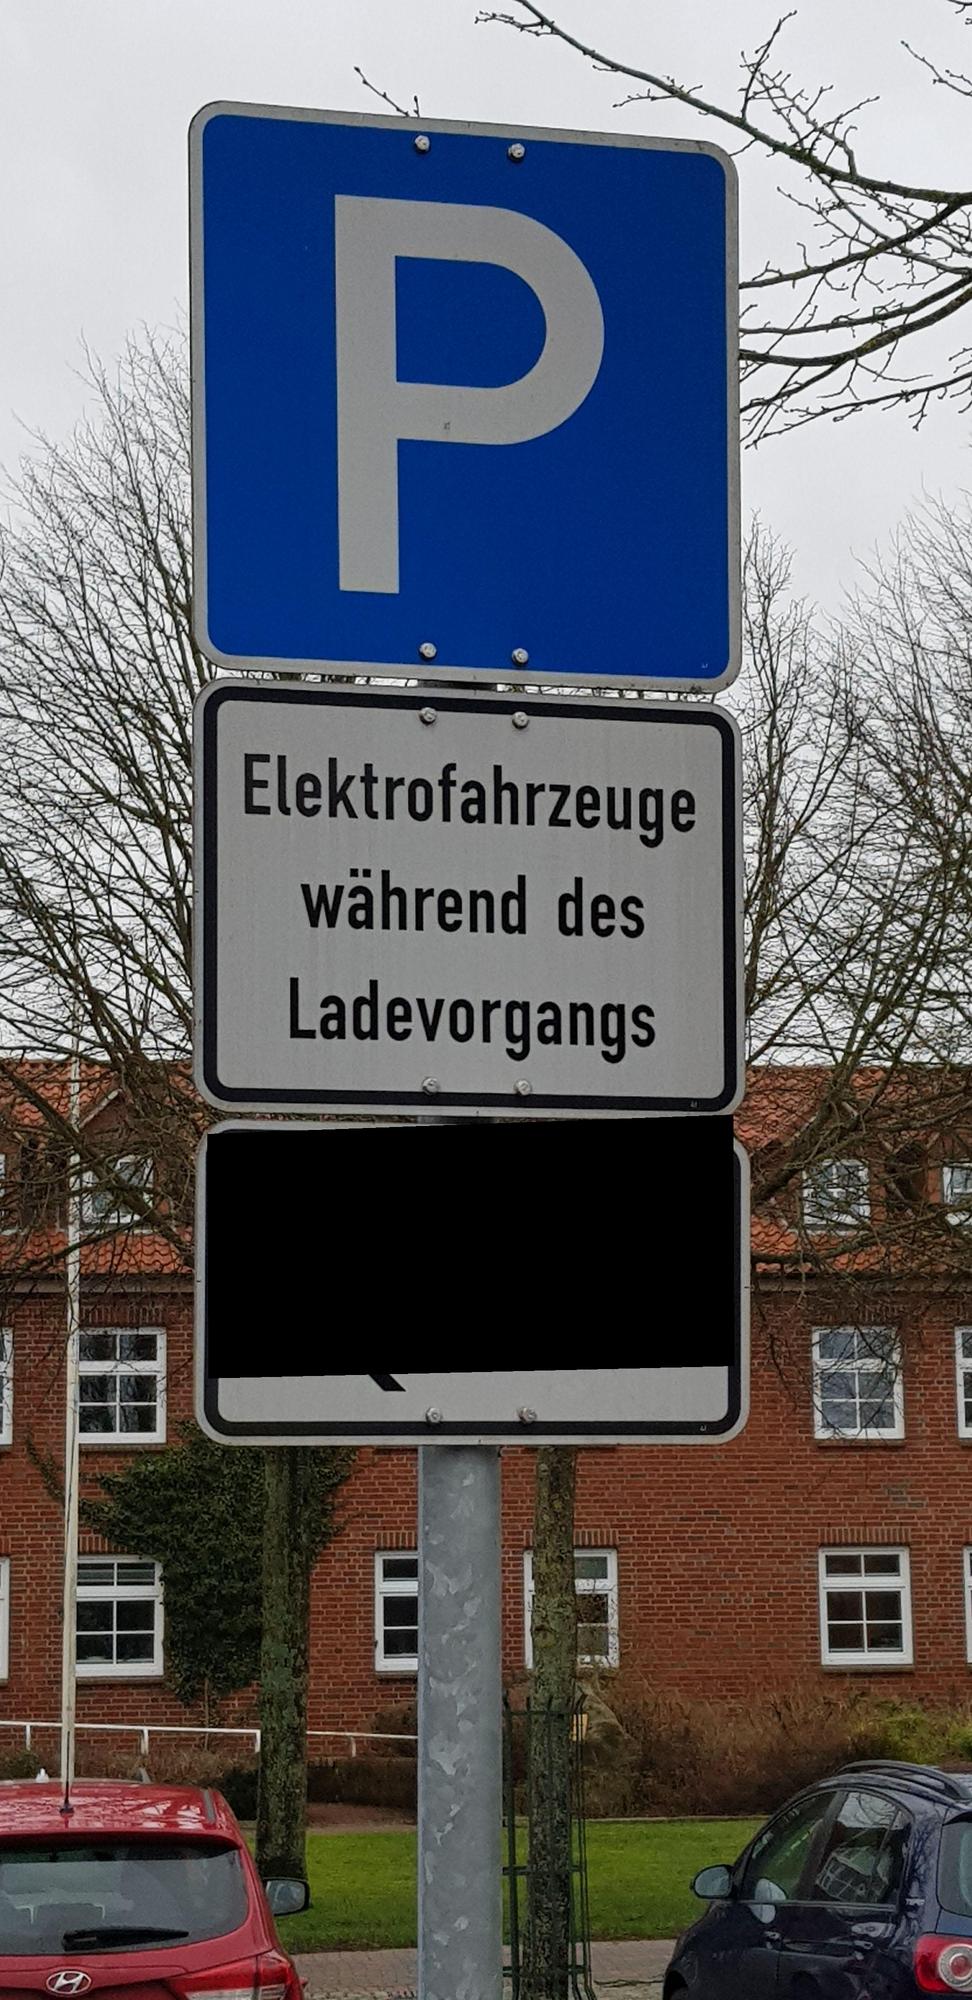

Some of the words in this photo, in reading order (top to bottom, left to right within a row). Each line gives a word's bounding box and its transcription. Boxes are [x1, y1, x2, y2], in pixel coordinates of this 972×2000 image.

[335, 195, 604, 593] P
[243, 753, 696, 848] Elektrofahrzeuge
[300, 868, 527, 934] während
[557, 877, 645, 938] des
[290, 977, 656, 1064] Ladevorgangs
